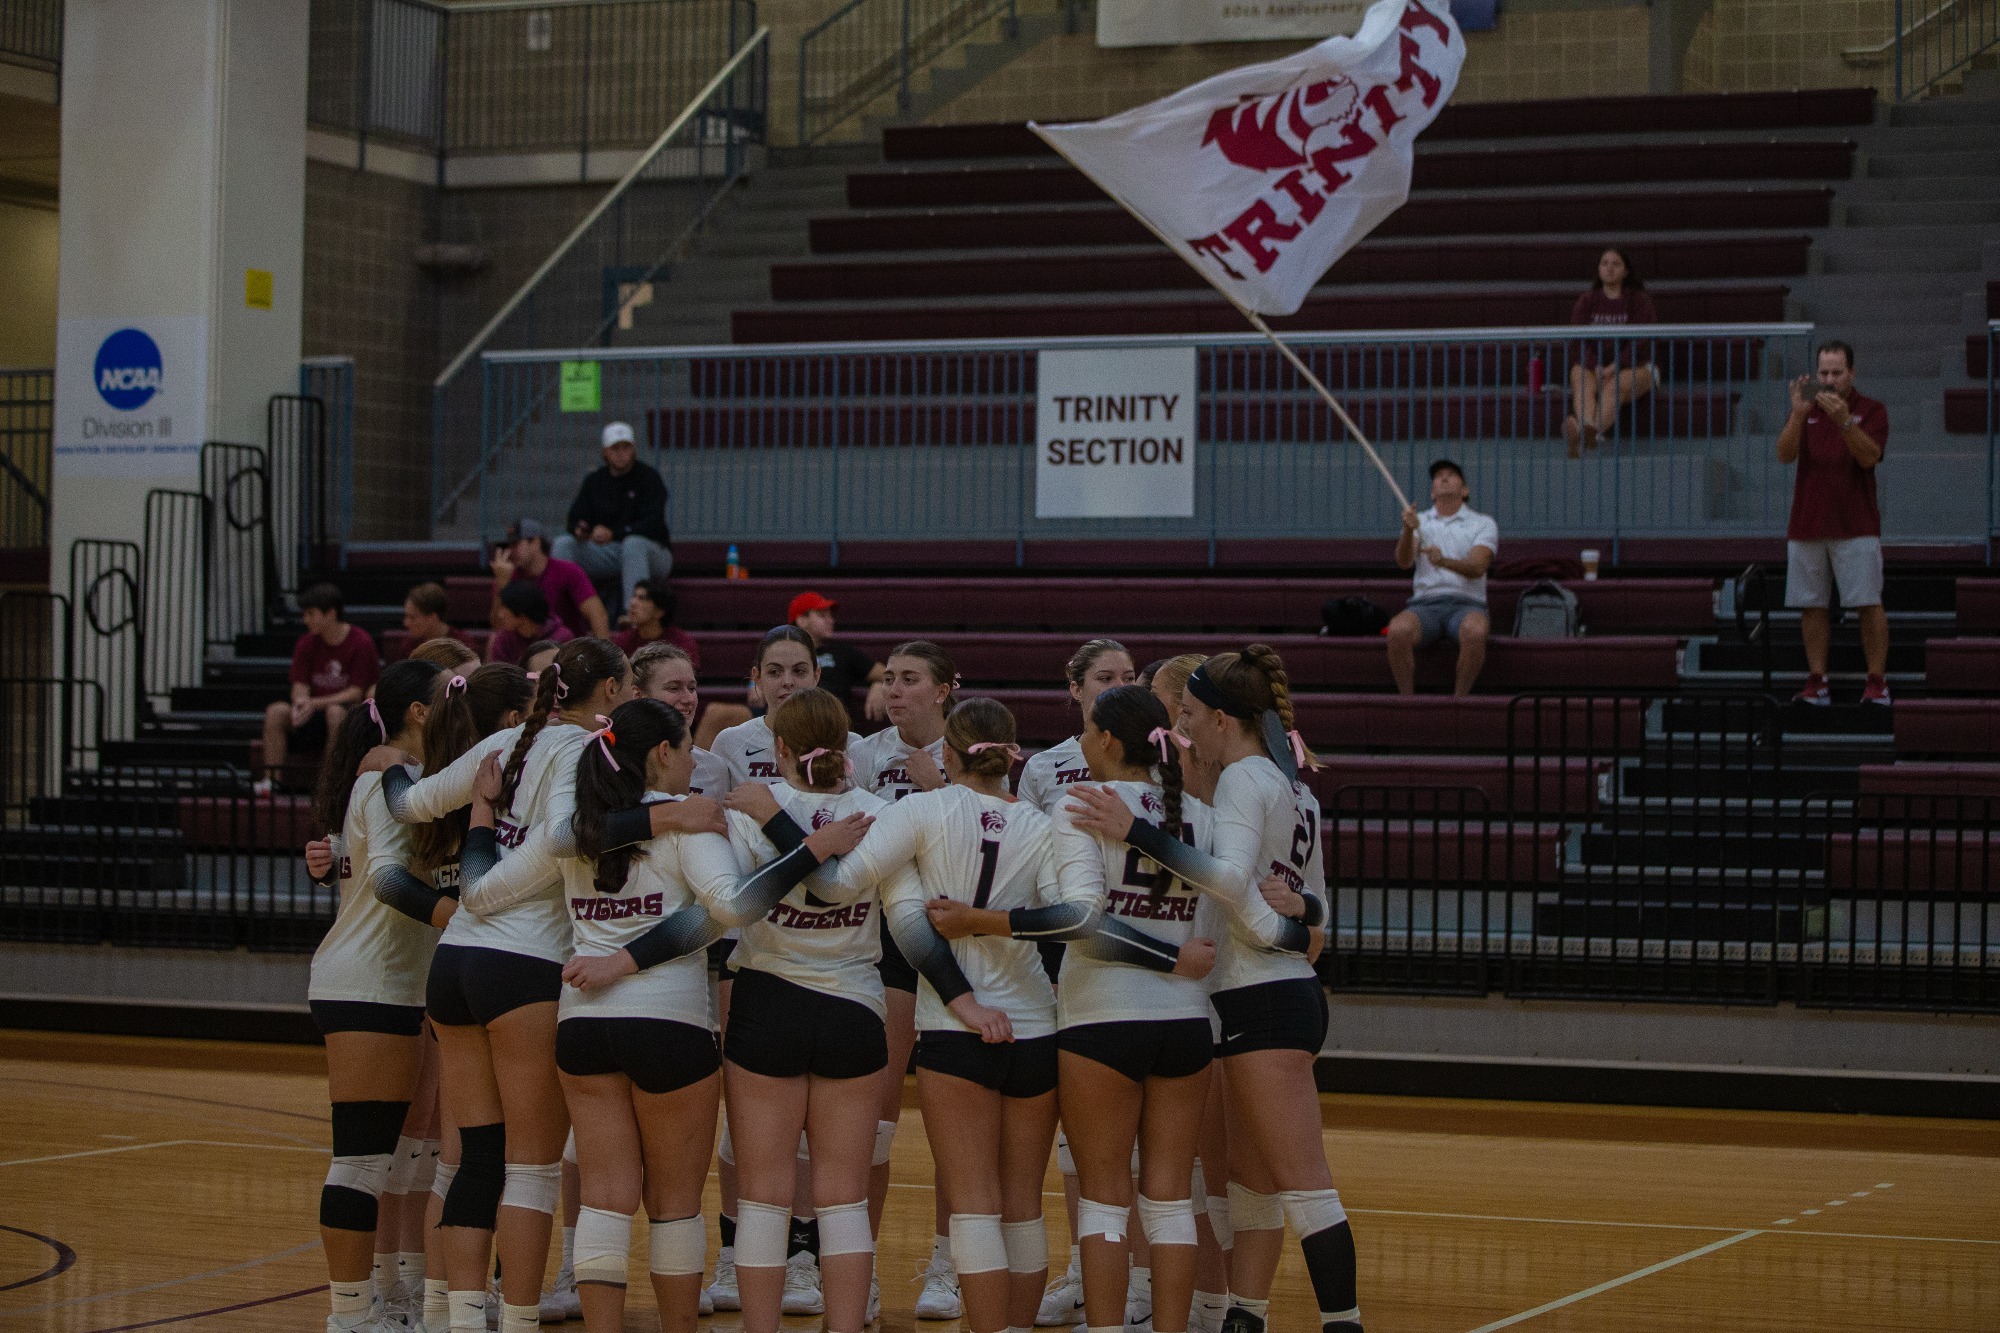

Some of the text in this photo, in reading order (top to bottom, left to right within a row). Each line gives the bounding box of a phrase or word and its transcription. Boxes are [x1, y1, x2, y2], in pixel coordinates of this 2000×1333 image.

[1186, 0, 1449, 281] TRINITY
[100, 366, 161, 391] NCAA
[1053, 394, 1179, 423] TRINITY
[83, 418, 153, 439] Division
[1048, 437, 1182, 466] SECTION
[571, 892, 663, 921] TIGERS
[767, 901, 872, 929] TIGERS
[1105, 889, 1199, 922] TIGERS
